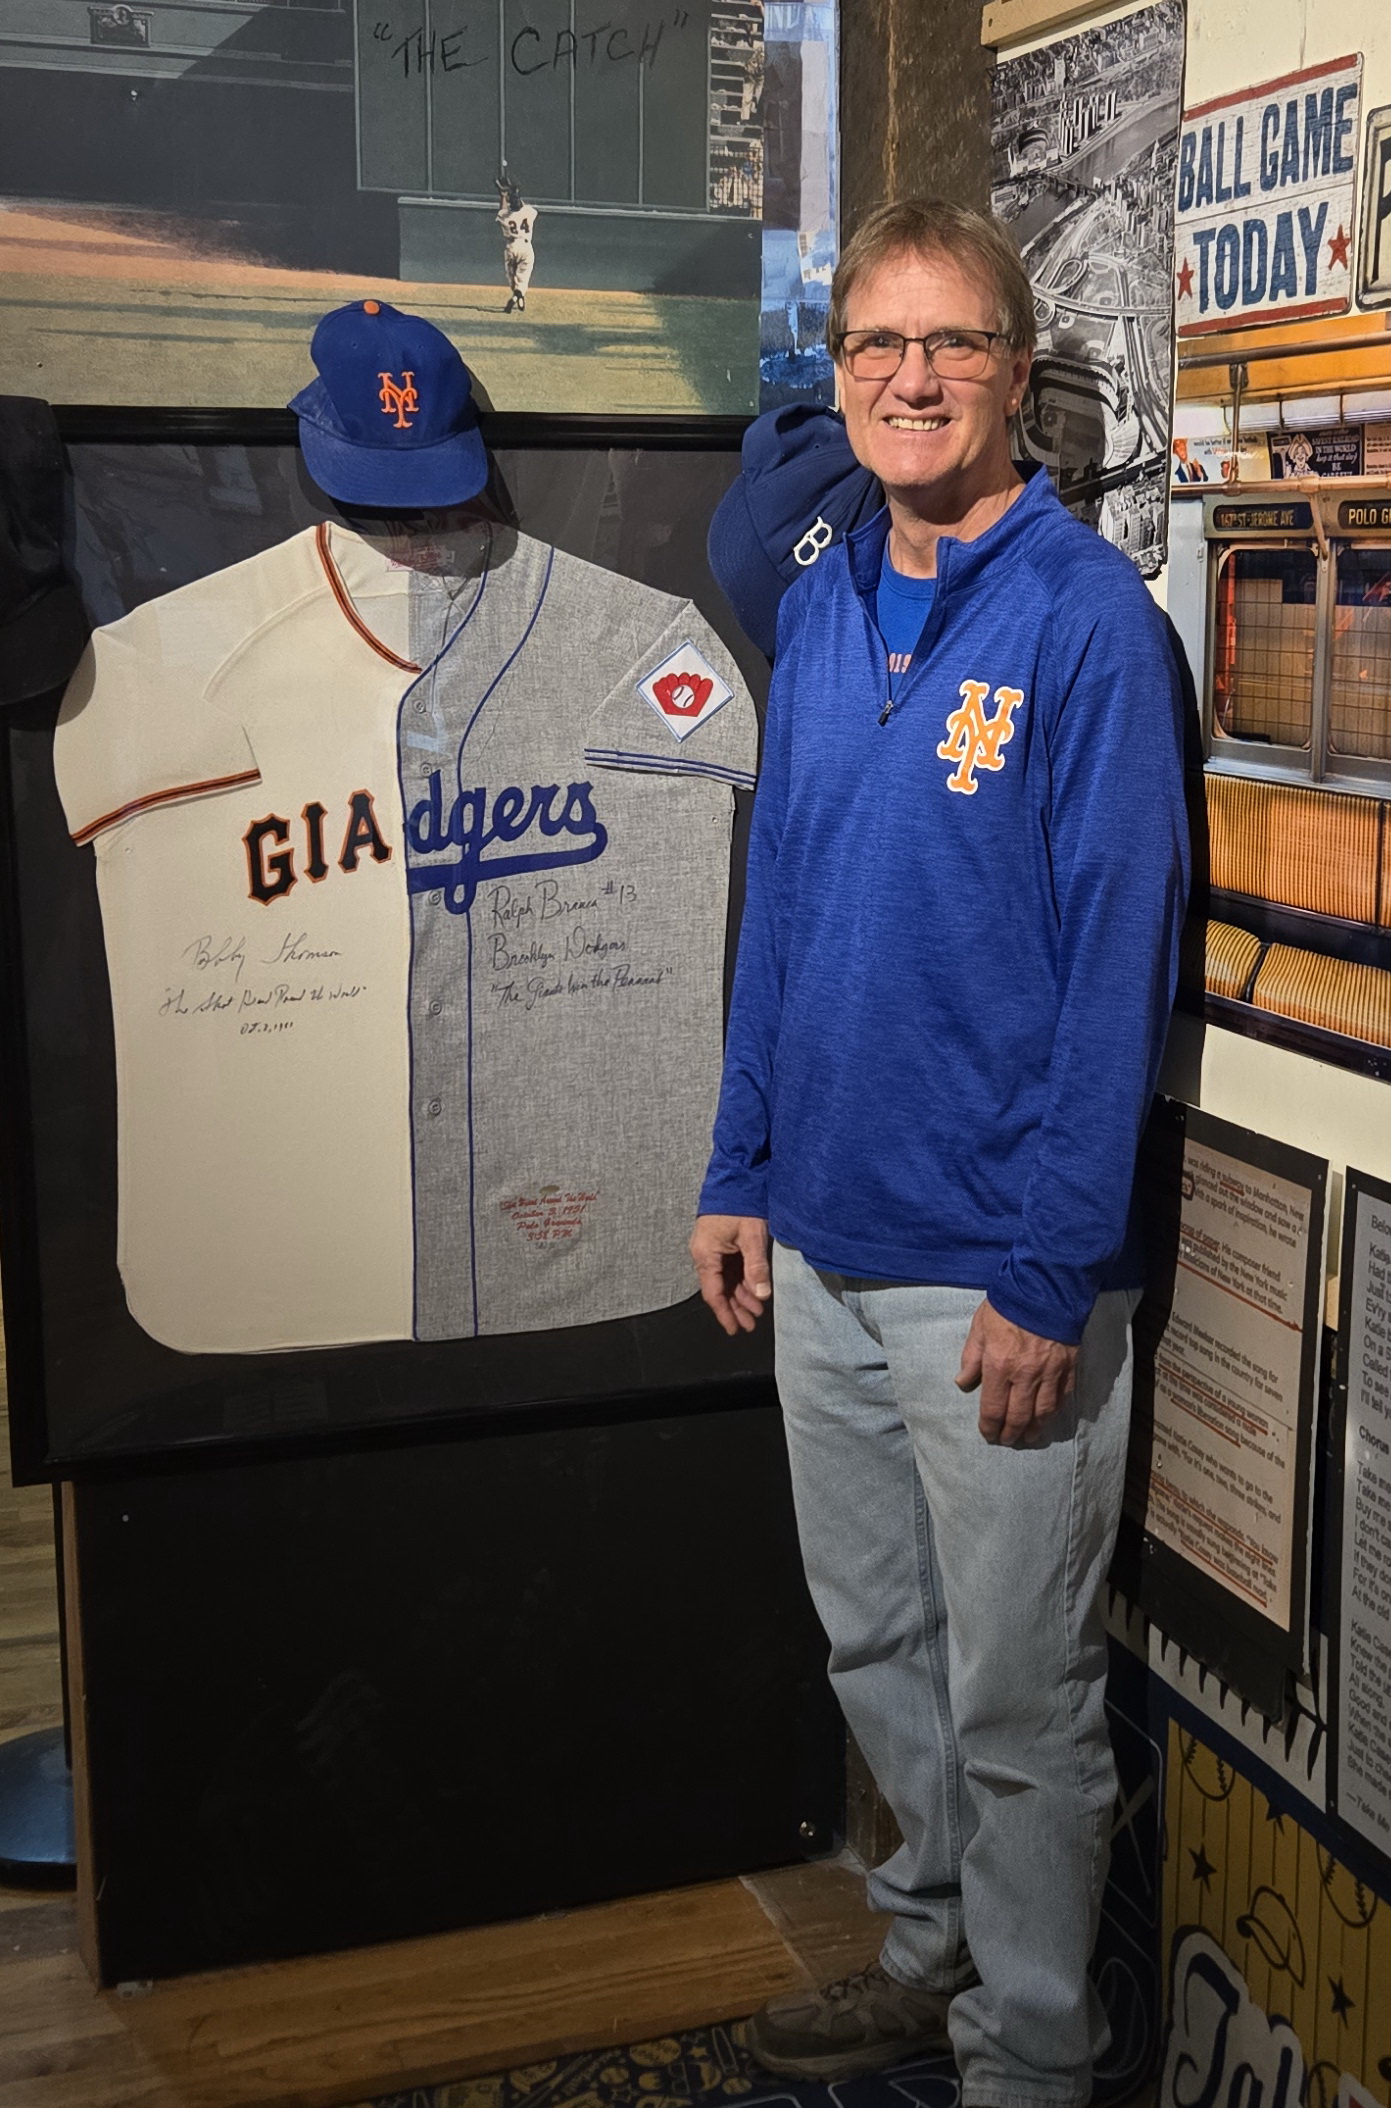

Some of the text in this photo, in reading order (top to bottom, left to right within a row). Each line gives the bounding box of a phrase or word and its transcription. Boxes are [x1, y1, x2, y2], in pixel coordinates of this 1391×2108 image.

[1178, 83, 1358, 212] BALL GAME
[508, 218, 530, 235] 24
[1193, 202, 1329, 314] TODAY
[793, 516, 833, 565] B
[1348, 508, 1377, 525] POLO
[242, 769, 608, 915] GIA dgers
